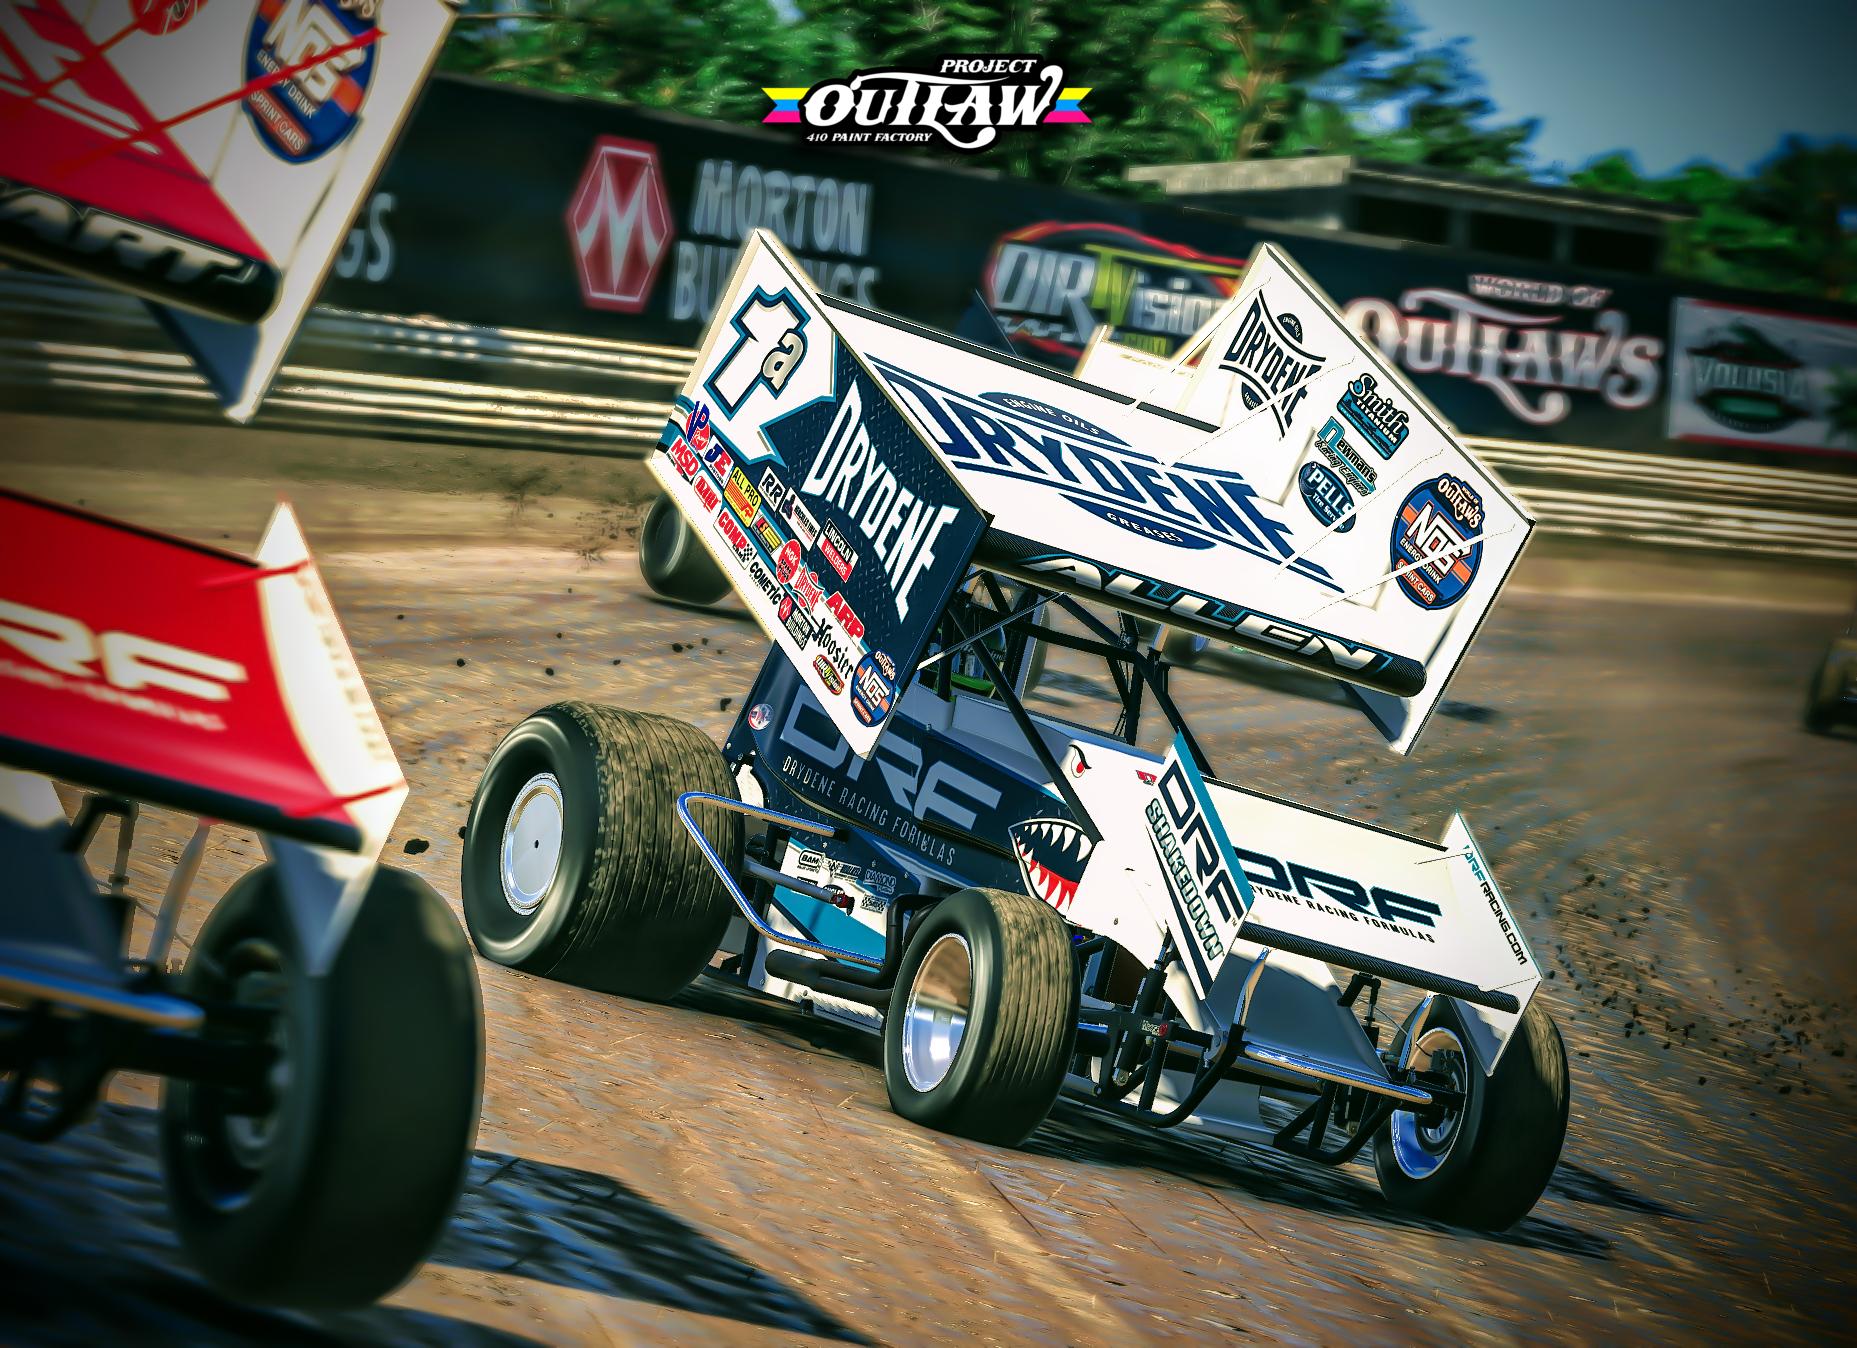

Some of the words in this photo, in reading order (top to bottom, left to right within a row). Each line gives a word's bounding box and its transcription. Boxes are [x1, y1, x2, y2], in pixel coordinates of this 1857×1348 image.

[694, 159, 872, 255] MORTON
[1223, 297, 1322, 429] DRYDENE
[1003, 398, 1057, 417] ENGINE
[1061, 414, 1101, 436] OILS
[1349, 373, 1408, 435] Smith
[1357, 399, 1398, 444] TITANIUM
[670, 437, 699, 476] MSD
[704, 443, 732, 477] JE
[874, 363, 1301, 557] DRYDENE
[732, 470, 746, 490] ALL
[744, 483, 760, 507] PRO
[800, 378, 960, 624] DRYDENE
[1308, 470, 1352, 515] PELLS
[1312, 493, 1326, 509] Tire
[1437, 478, 1481, 528] OUTLAWS
[718, 512, 748, 550] COMP
[824, 523, 852, 563] LINCOLN
[1106, 512, 1184, 543] GREASES
[1406, 501, 1472, 577] NOS
[784, 545, 799, 567] NGK
[824, 543, 848, 576] WELDERS
[1422, 563, 1441, 584] DRINK
[749, 561, 782, 606] COMETIC
[1417, 582, 1435, 602] CARS
[826, 593, 864, 640] ARP
[812, 617, 854, 680] Hoosier
[782, 755, 836, 797] DRYDENE
[840, 786, 888, 825] RACING
[1158, 760, 1244, 922] DRF
[1145, 798, 1224, 961] SHAKEDOWN
[1233, 846, 1442, 928] DRF
[1308, 900, 1359, 922] RACING
[1363, 916, 1435, 943] FORMULAS
